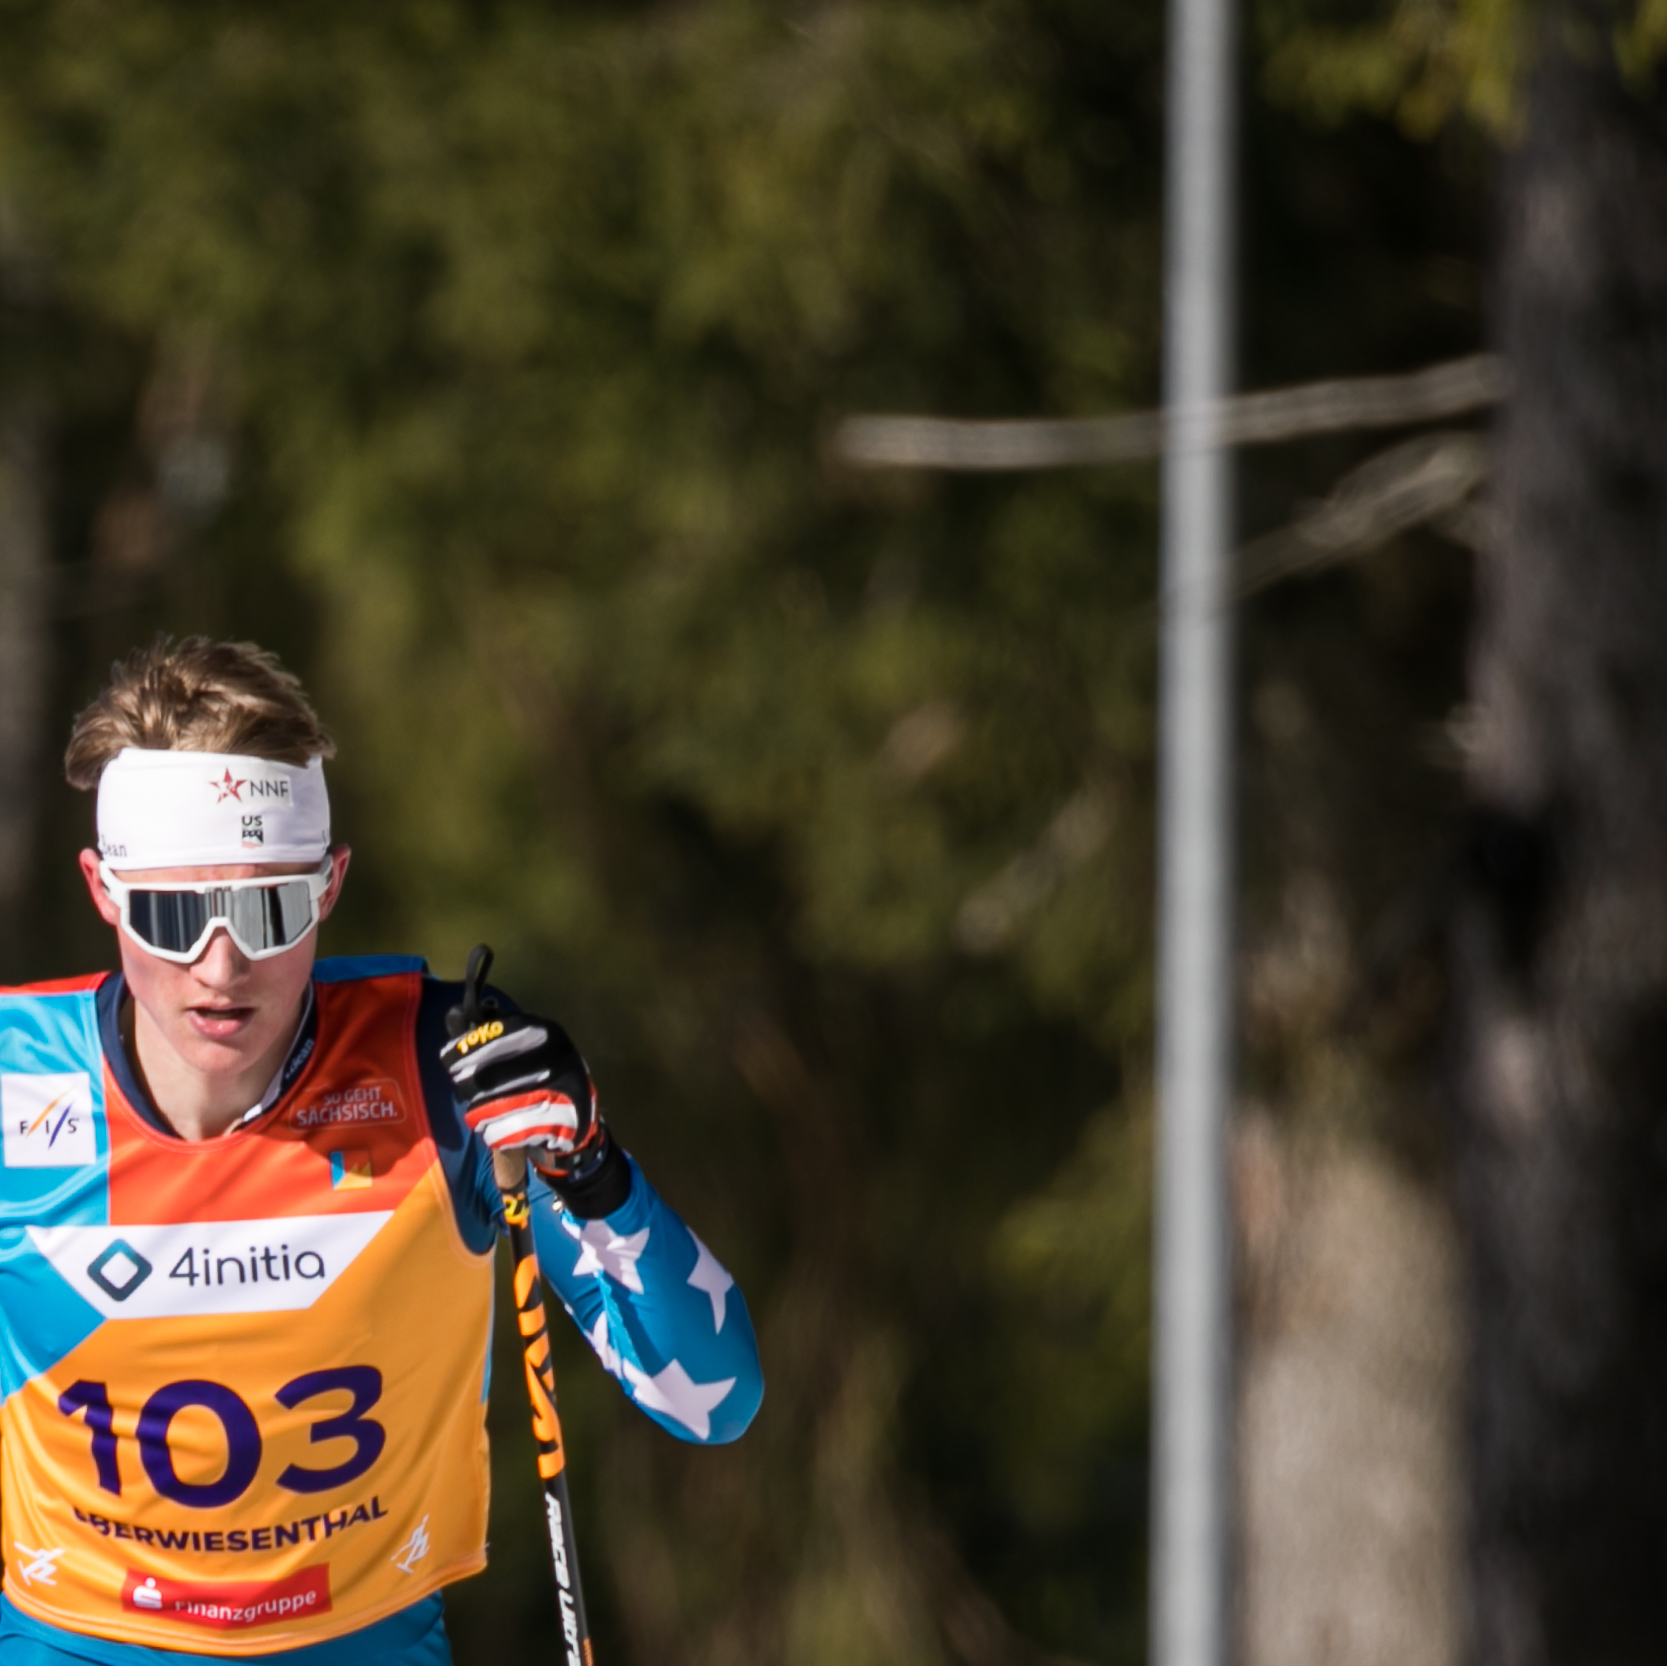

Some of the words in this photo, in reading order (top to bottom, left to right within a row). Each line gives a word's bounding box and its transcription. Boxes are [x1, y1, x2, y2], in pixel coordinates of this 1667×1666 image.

[456, 1020, 505, 1055] TOKO
[343, 1085, 382, 1104] GEHT
[169, 1243, 326, 1288] 4initia
[55, 1364, 388, 1510] 103
